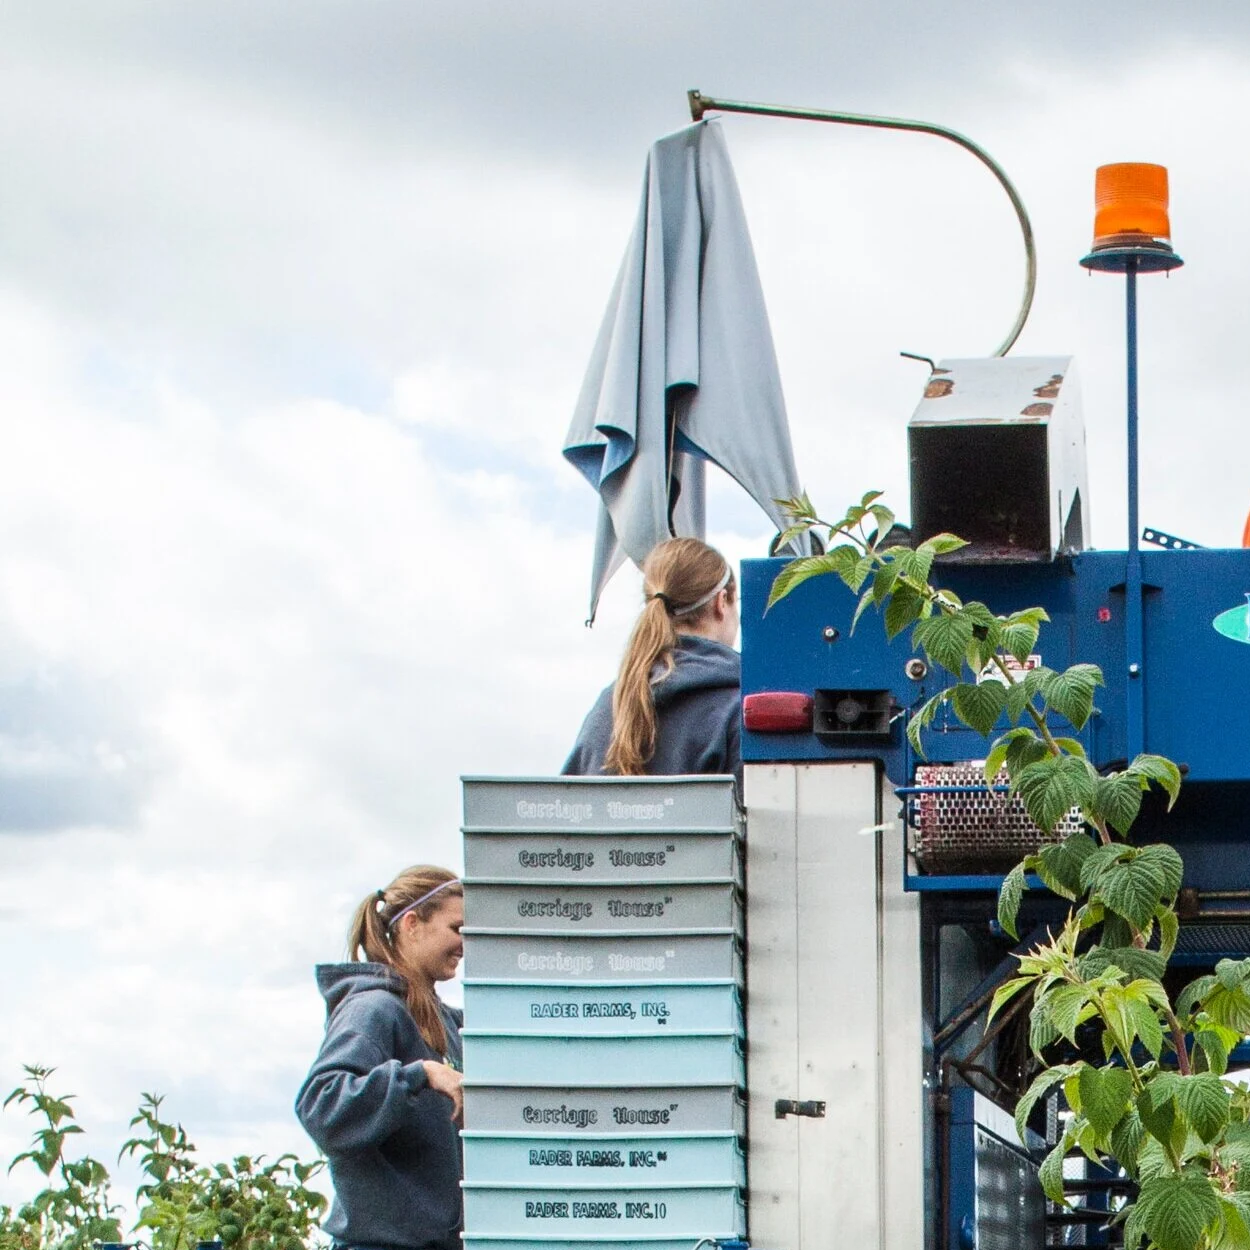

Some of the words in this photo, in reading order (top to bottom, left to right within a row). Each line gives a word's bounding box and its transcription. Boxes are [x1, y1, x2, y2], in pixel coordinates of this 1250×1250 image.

[517, 800, 592, 823] Carriage
[519, 848, 594, 871] Carriage
[518, 899, 592, 920] Carriage
[518, 952, 593, 975] Carriage
[531, 1002, 578, 1017] RADER
[642, 1003, 670, 1017] INC.
[523, 1105, 597, 1128] Carriage
[530, 1150, 572, 1166] RADER
[629, 1151, 656, 1167] INC.
[526, 1202, 568, 1217] RADER
